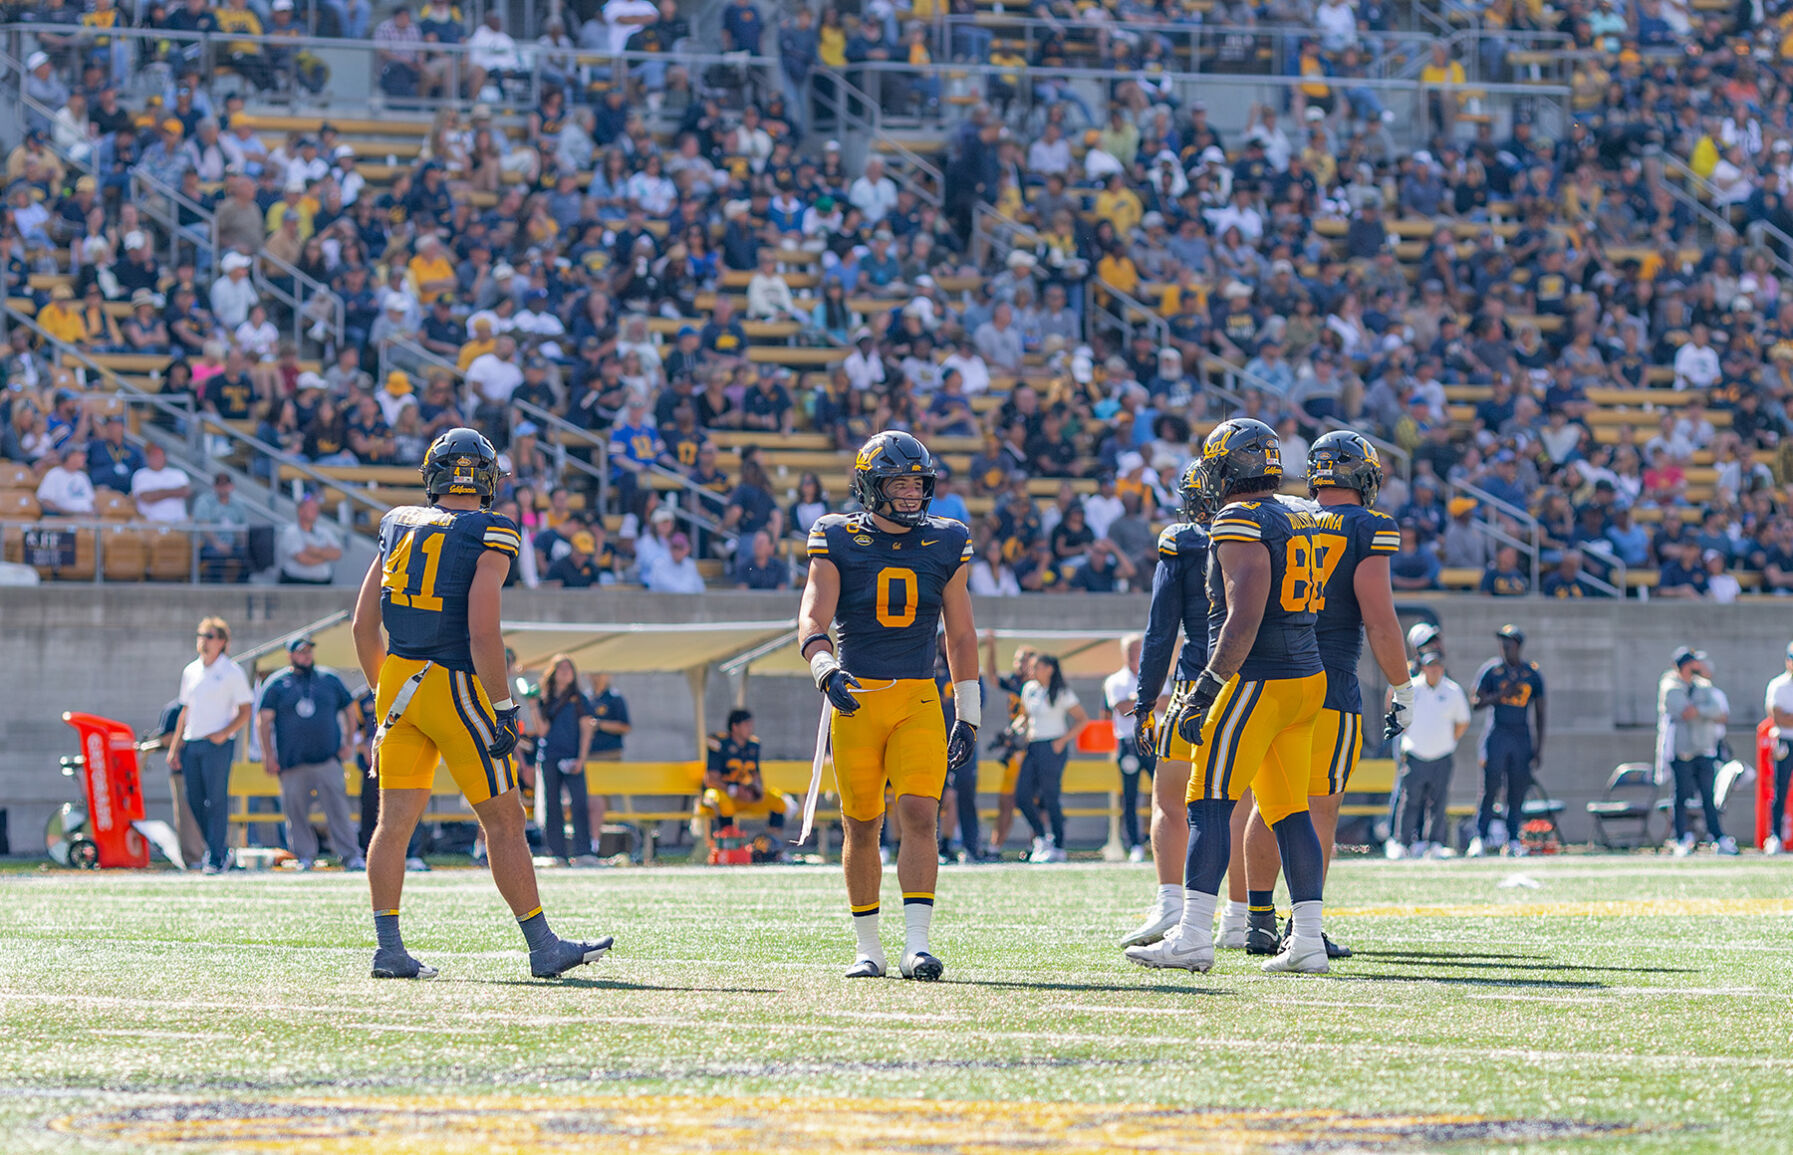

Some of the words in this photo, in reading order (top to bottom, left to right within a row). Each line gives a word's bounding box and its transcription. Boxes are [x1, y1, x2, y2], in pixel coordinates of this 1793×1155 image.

[1202, 431, 1231, 460] Cal
[381, 530, 446, 612] 41
[876, 567, 918, 628] 0
